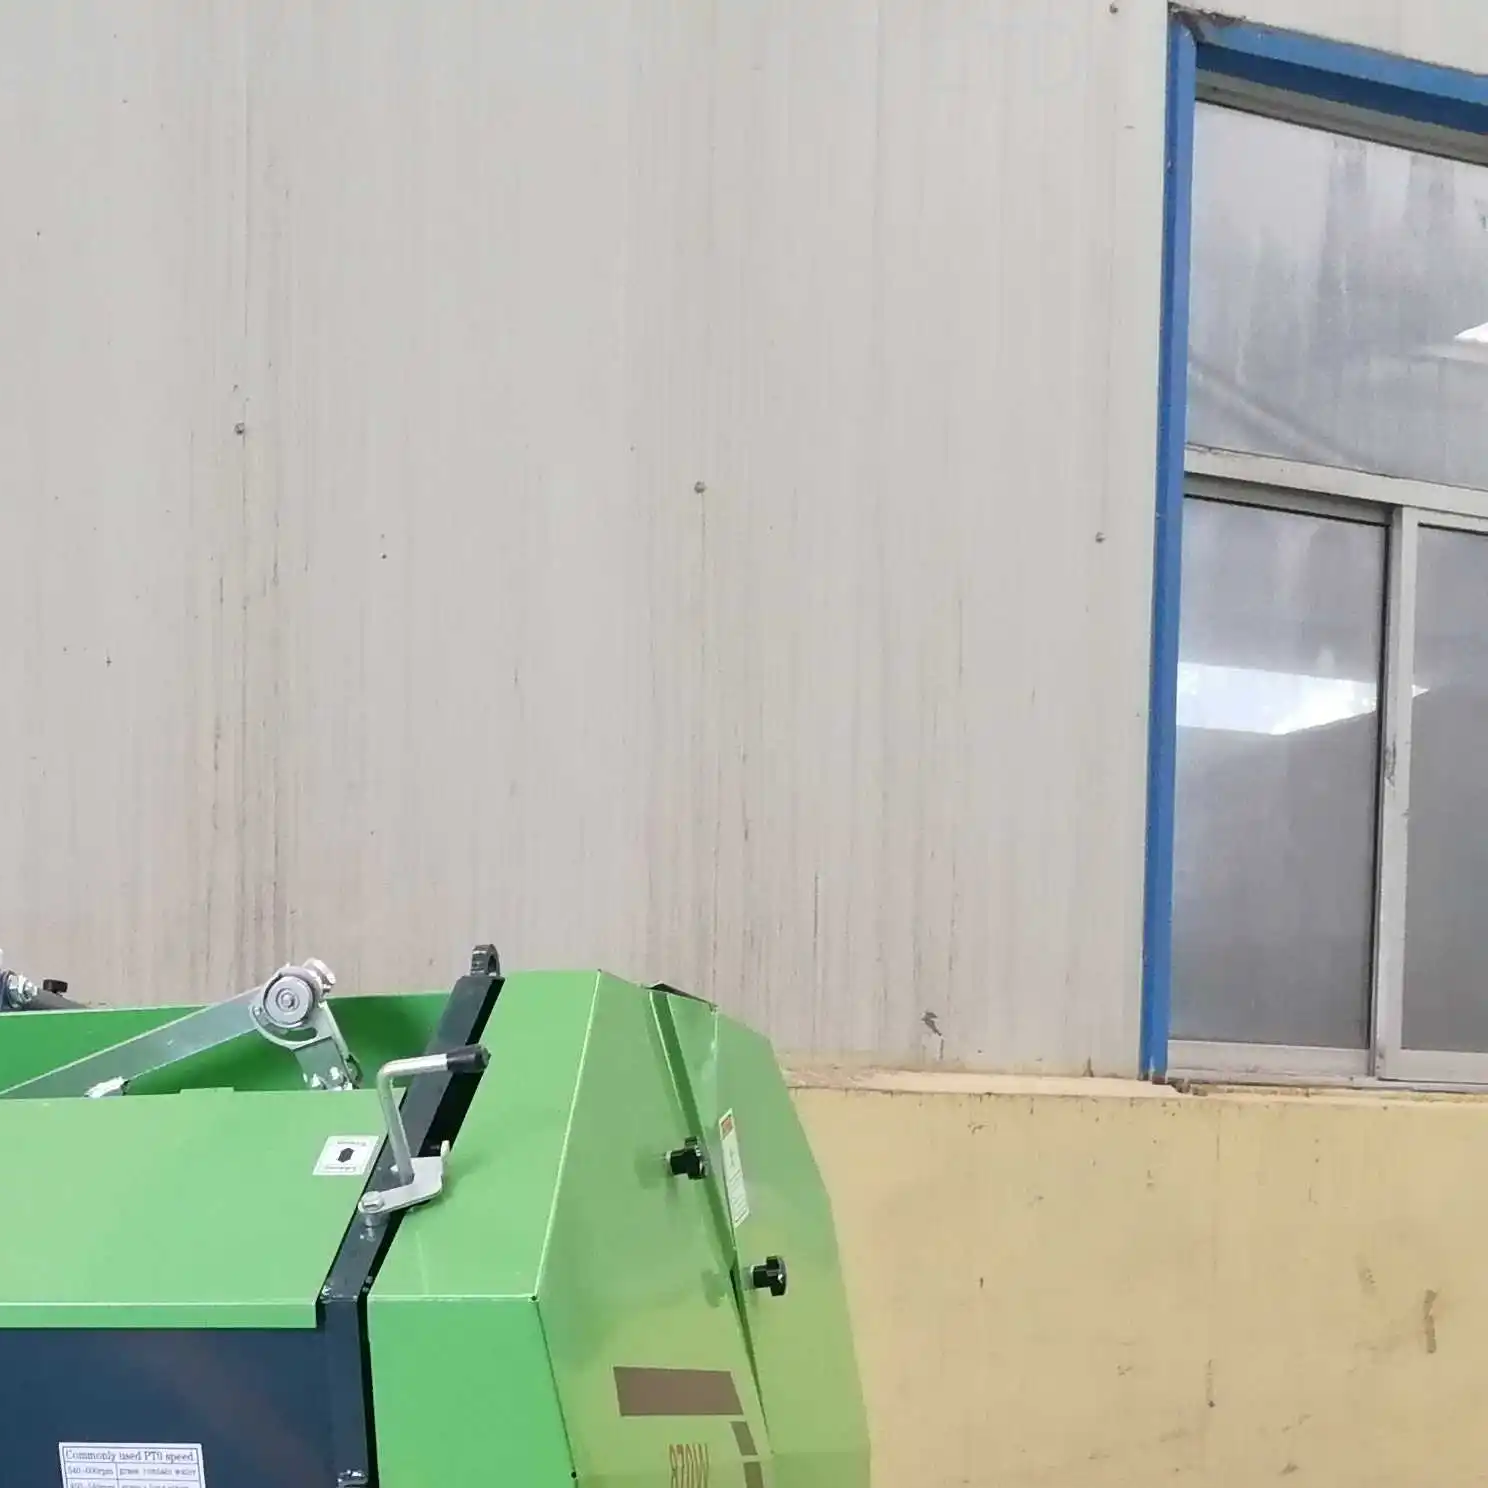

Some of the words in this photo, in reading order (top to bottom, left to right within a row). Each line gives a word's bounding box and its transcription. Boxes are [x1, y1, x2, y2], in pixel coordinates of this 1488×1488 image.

[66, 1449, 116, 1462] Commonly
[119, 1451, 141, 1461] used
[166, 1451, 194, 1464] speed
